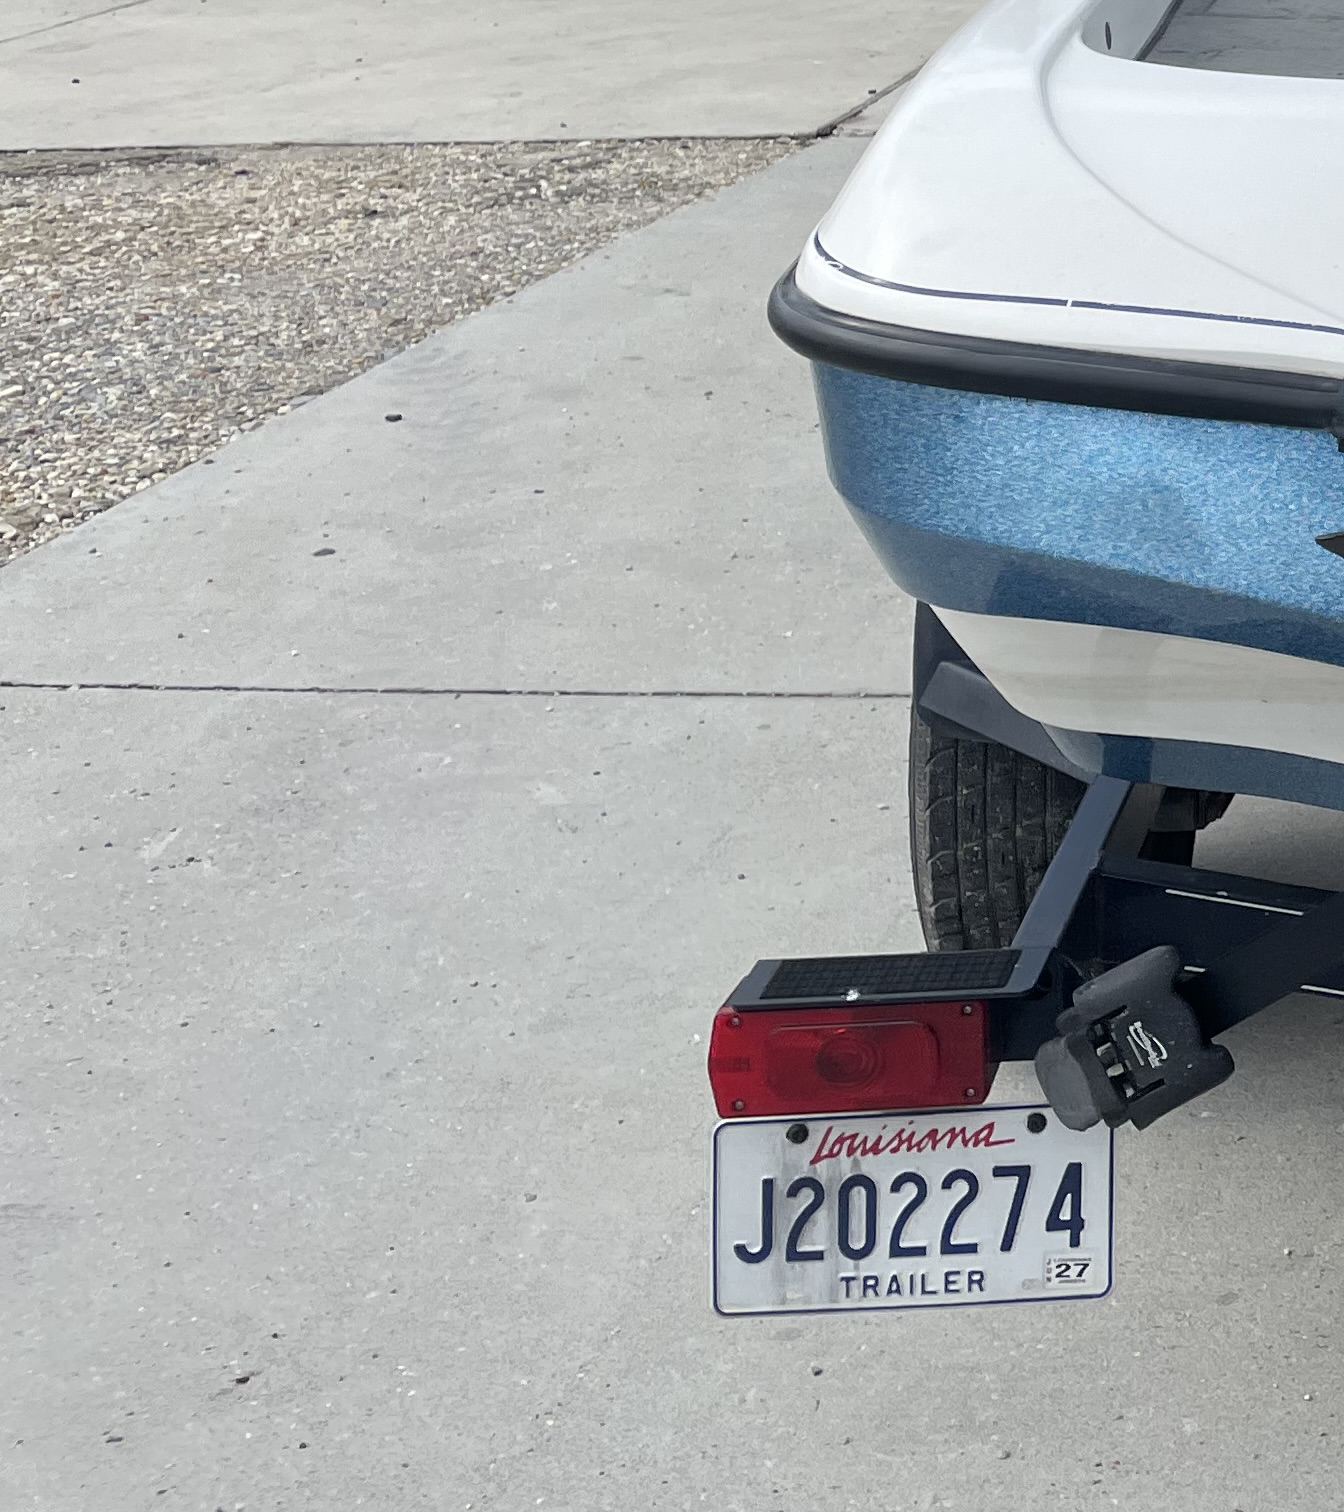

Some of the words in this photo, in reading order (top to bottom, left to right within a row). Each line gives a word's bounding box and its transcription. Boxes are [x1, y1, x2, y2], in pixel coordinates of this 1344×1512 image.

[809, 1121, 1016, 1166] Louisiana
[732, 1161, 1086, 1264] J202274
[839, 1270, 986, 1299] TRAILER
[1055, 1263, 1090, 1278] 27
